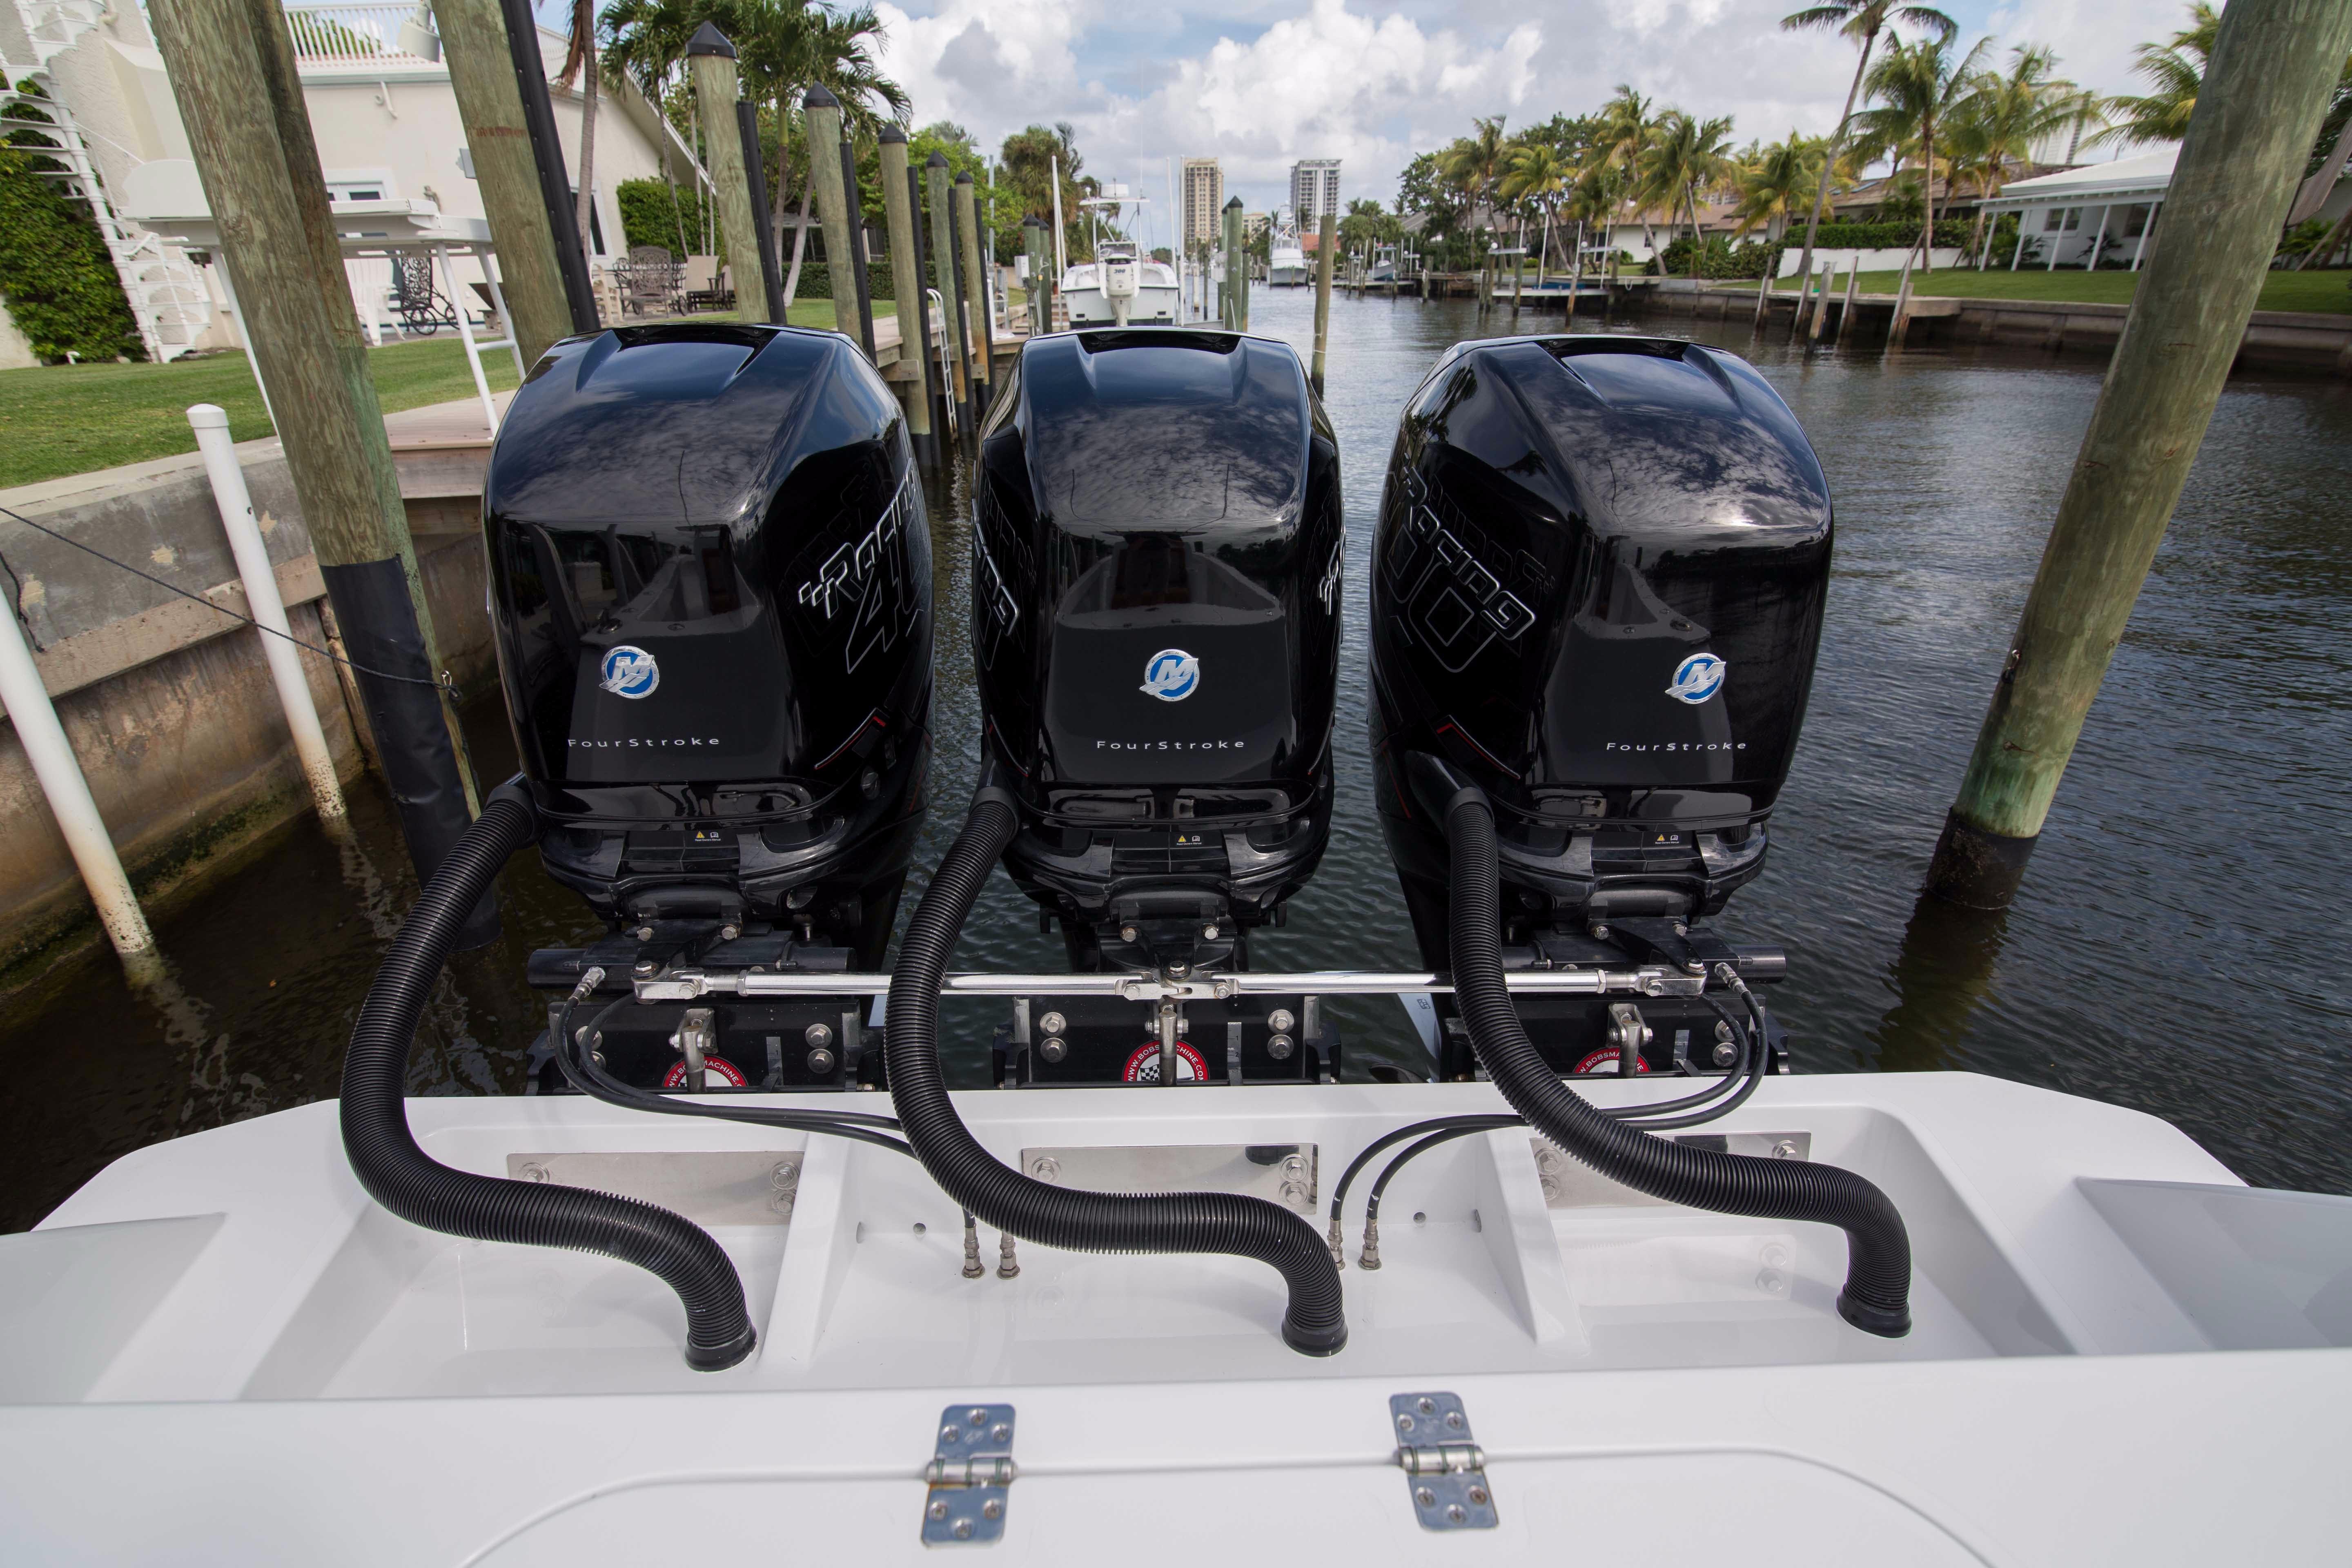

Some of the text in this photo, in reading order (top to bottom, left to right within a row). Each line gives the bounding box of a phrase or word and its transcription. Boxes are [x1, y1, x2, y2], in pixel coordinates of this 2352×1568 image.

[820, 457, 915, 619] Racing
[1403, 466, 1536, 640] Racing
[568, 737, 719, 747] FourStroke
[1097, 740, 1244, 750] FourStroke
[1606, 742, 1746, 751] FourStroke
[1128, 1045, 1204, 1081] WWW.BOBSCHINE.COM
